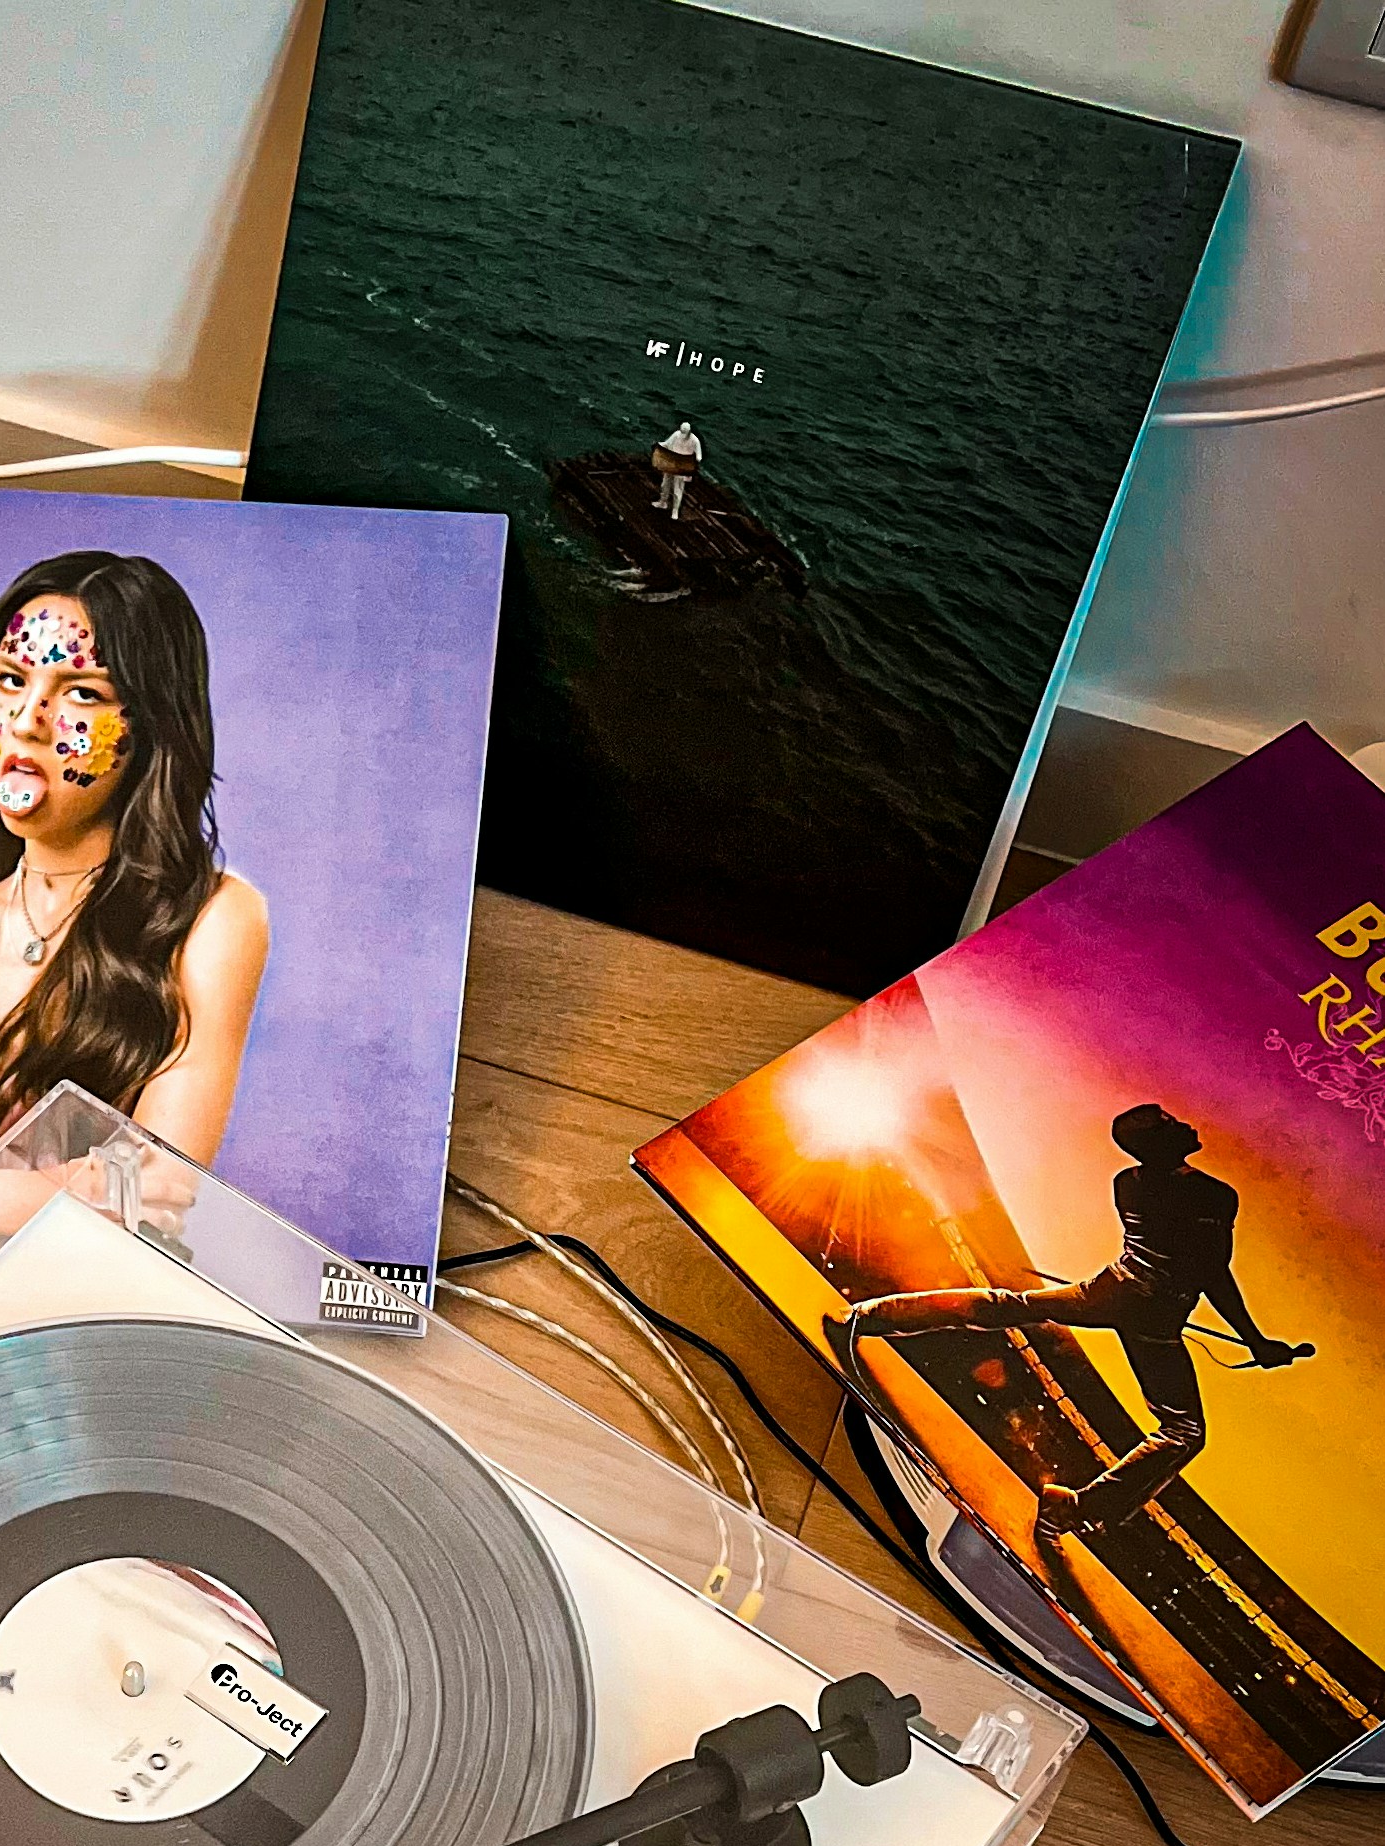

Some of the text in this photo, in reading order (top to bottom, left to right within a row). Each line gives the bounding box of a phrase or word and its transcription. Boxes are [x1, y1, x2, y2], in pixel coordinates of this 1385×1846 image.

[689, 351, 765, 383] HOPE
[1297, 972, 1385, 1069] RH
[325, 1307, 414, 1325] EXPLICIT CONTENT
[210, 1663, 303, 1738] Pro-Ject
